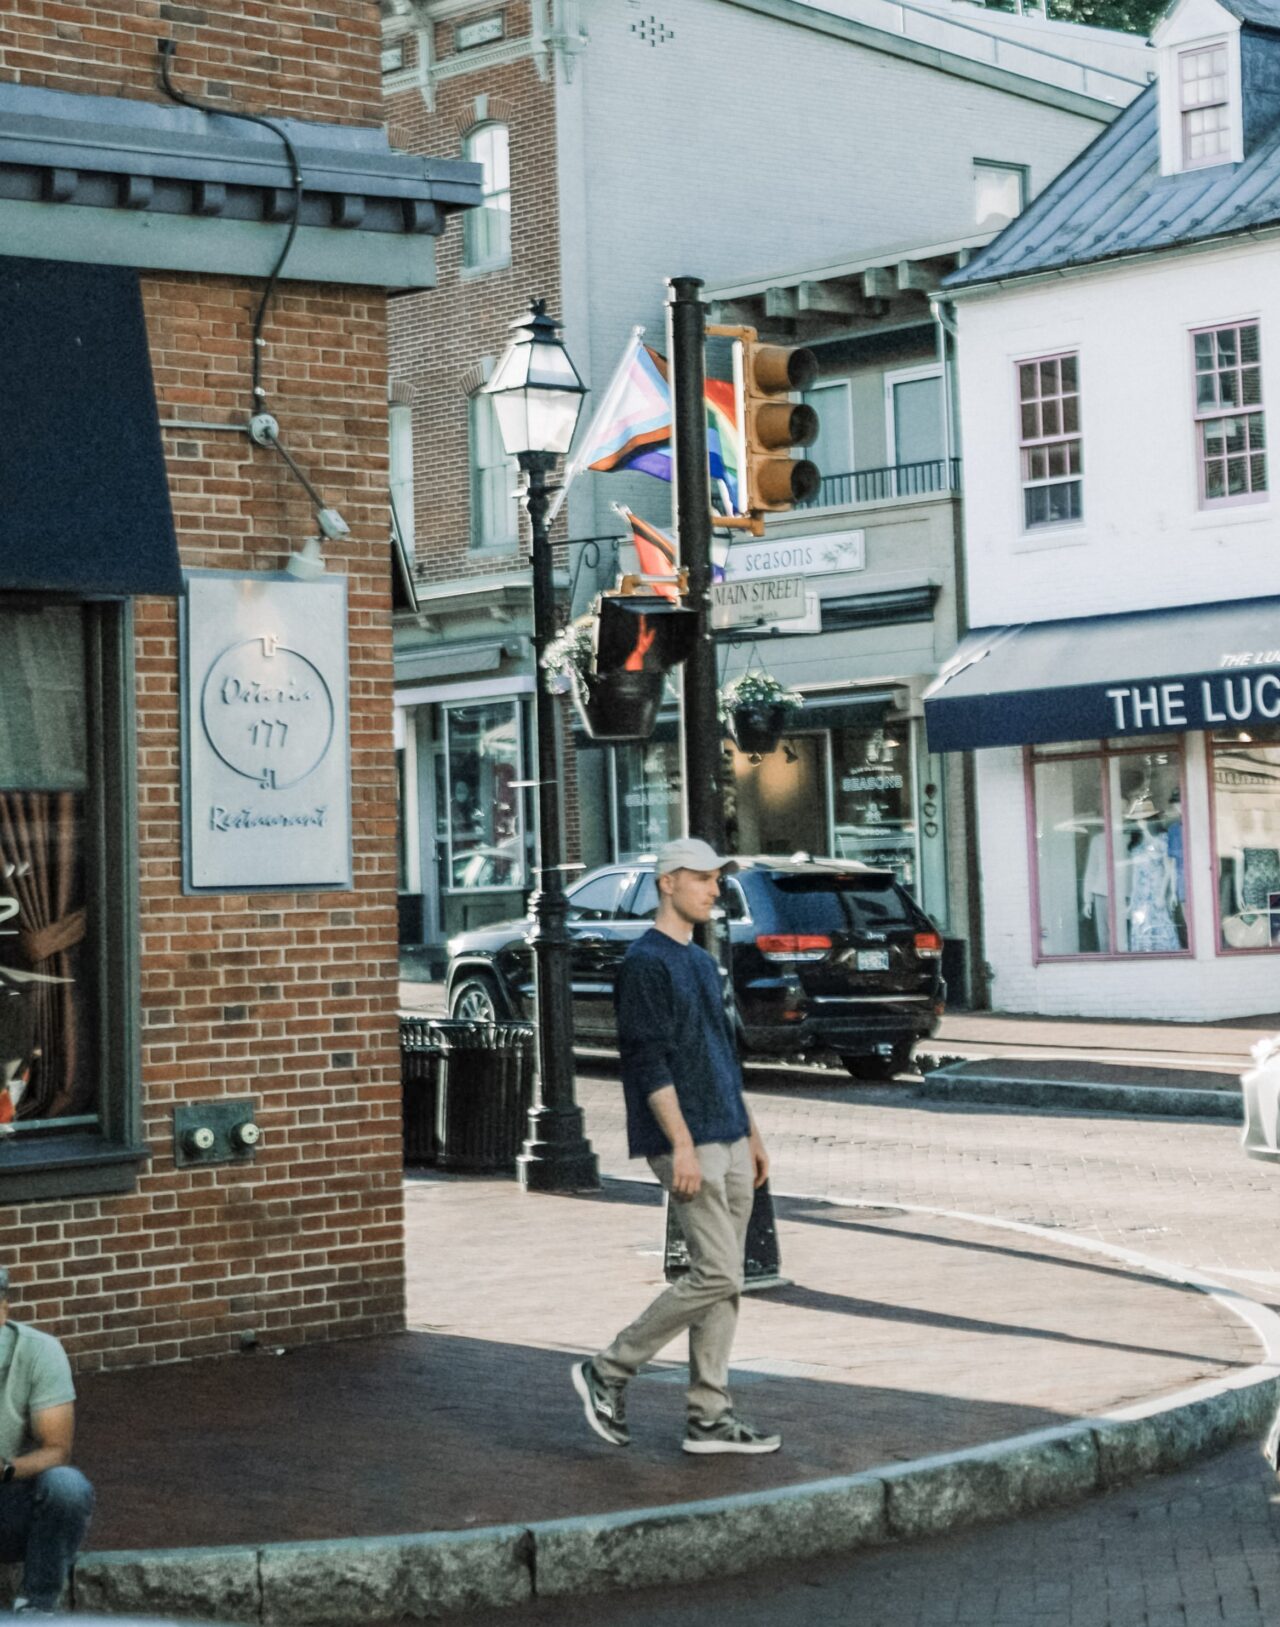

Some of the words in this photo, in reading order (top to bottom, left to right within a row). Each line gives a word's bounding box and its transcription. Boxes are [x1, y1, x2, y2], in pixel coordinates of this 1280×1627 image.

[745, 547, 813, 572] seasons
[714, 585, 749, 606] MAIN
[750, 577, 802, 602] STREET
[1221, 653, 1253, 667] THE
[1106, 684, 1187, 729] THE
[842, 776, 903, 791] SEASONS
